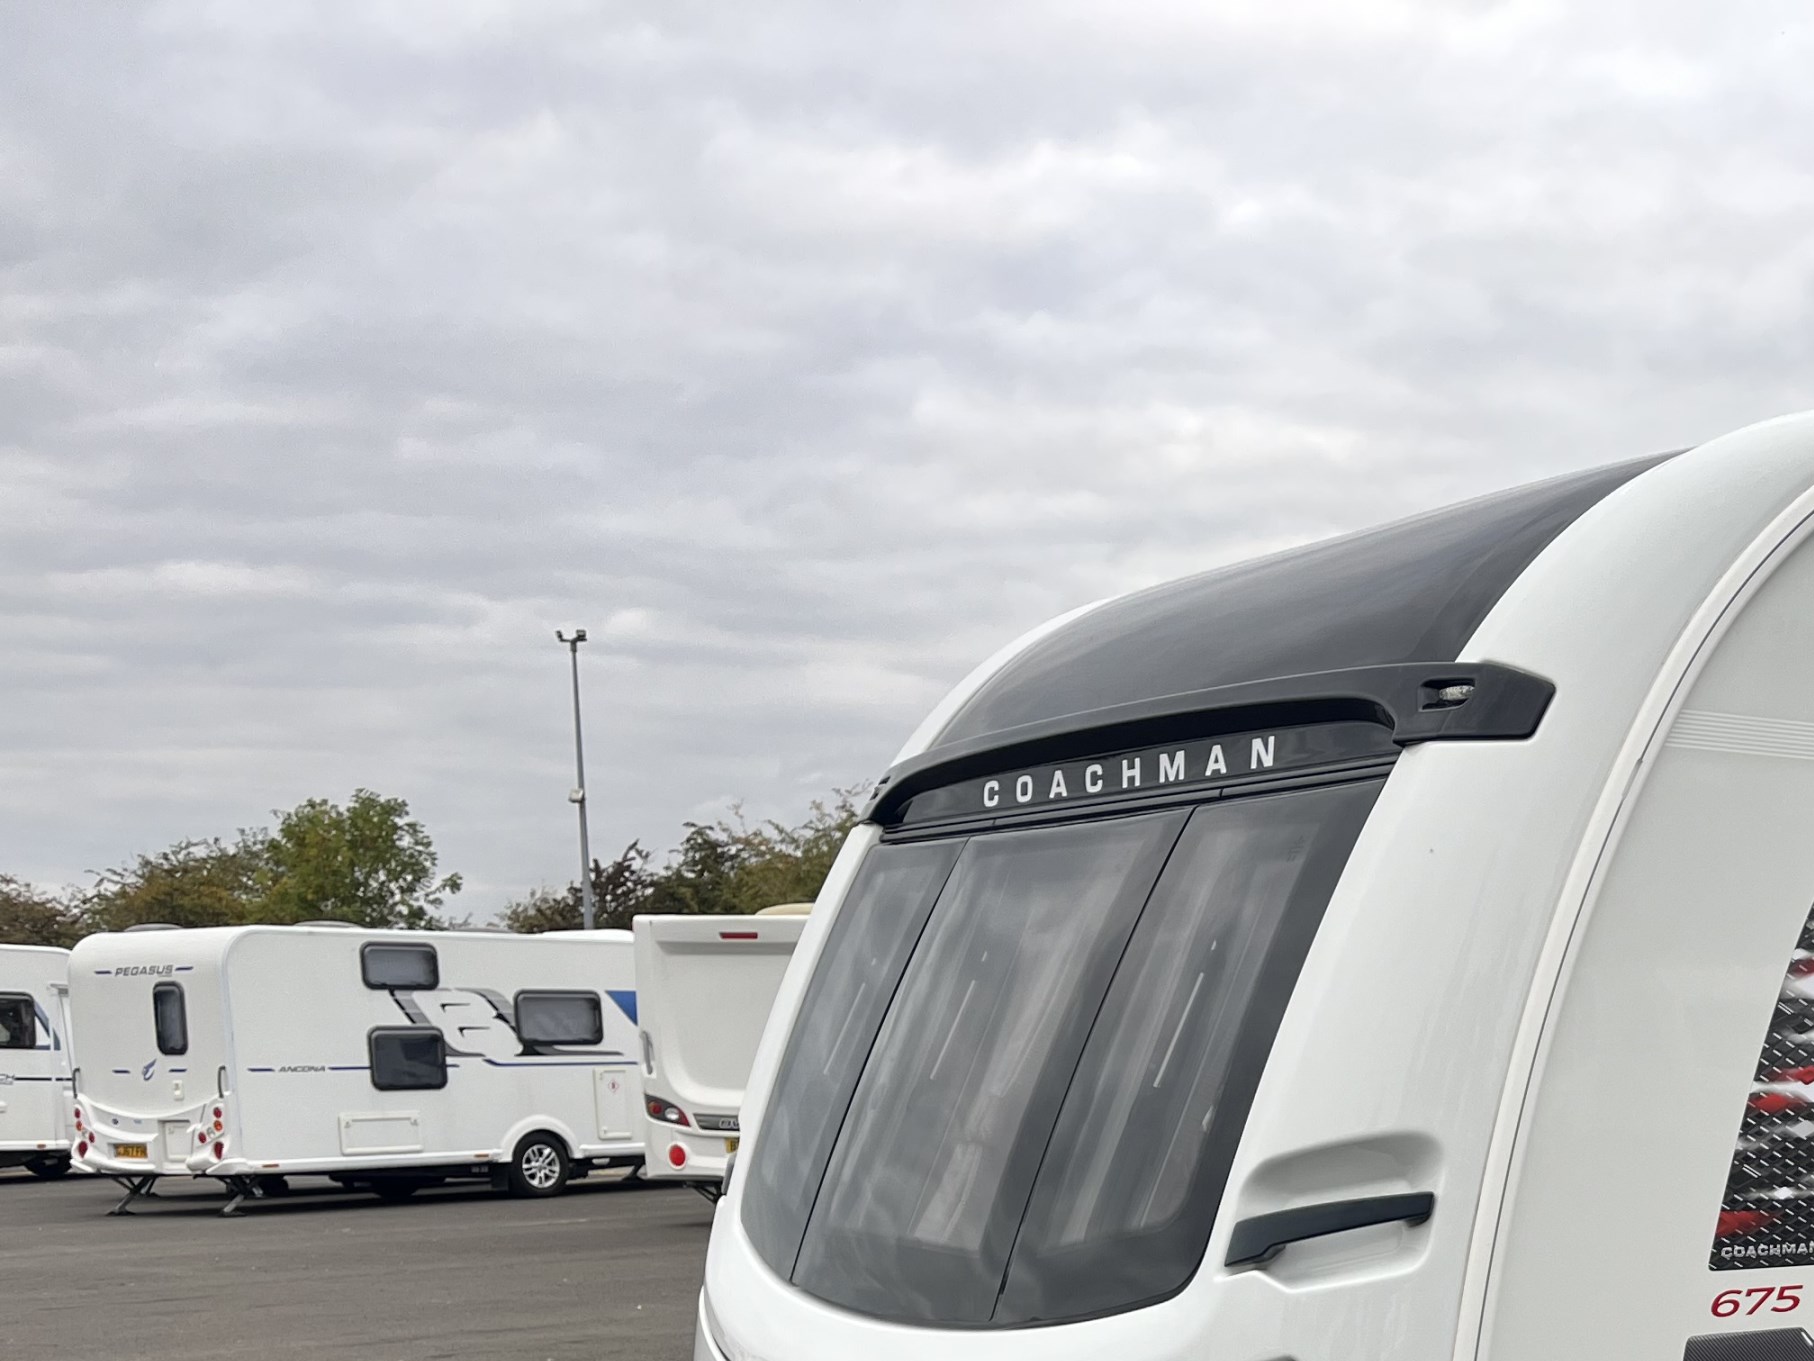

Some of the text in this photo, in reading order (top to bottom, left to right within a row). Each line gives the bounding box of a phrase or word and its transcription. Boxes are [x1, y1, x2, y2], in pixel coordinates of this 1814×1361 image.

[983, 736, 1276, 807] COACHMAN
[115, 965, 173, 976] PEGASUS
[279, 1065, 326, 1073] ANCONA
[1710, 1285, 1804, 1317] 675
